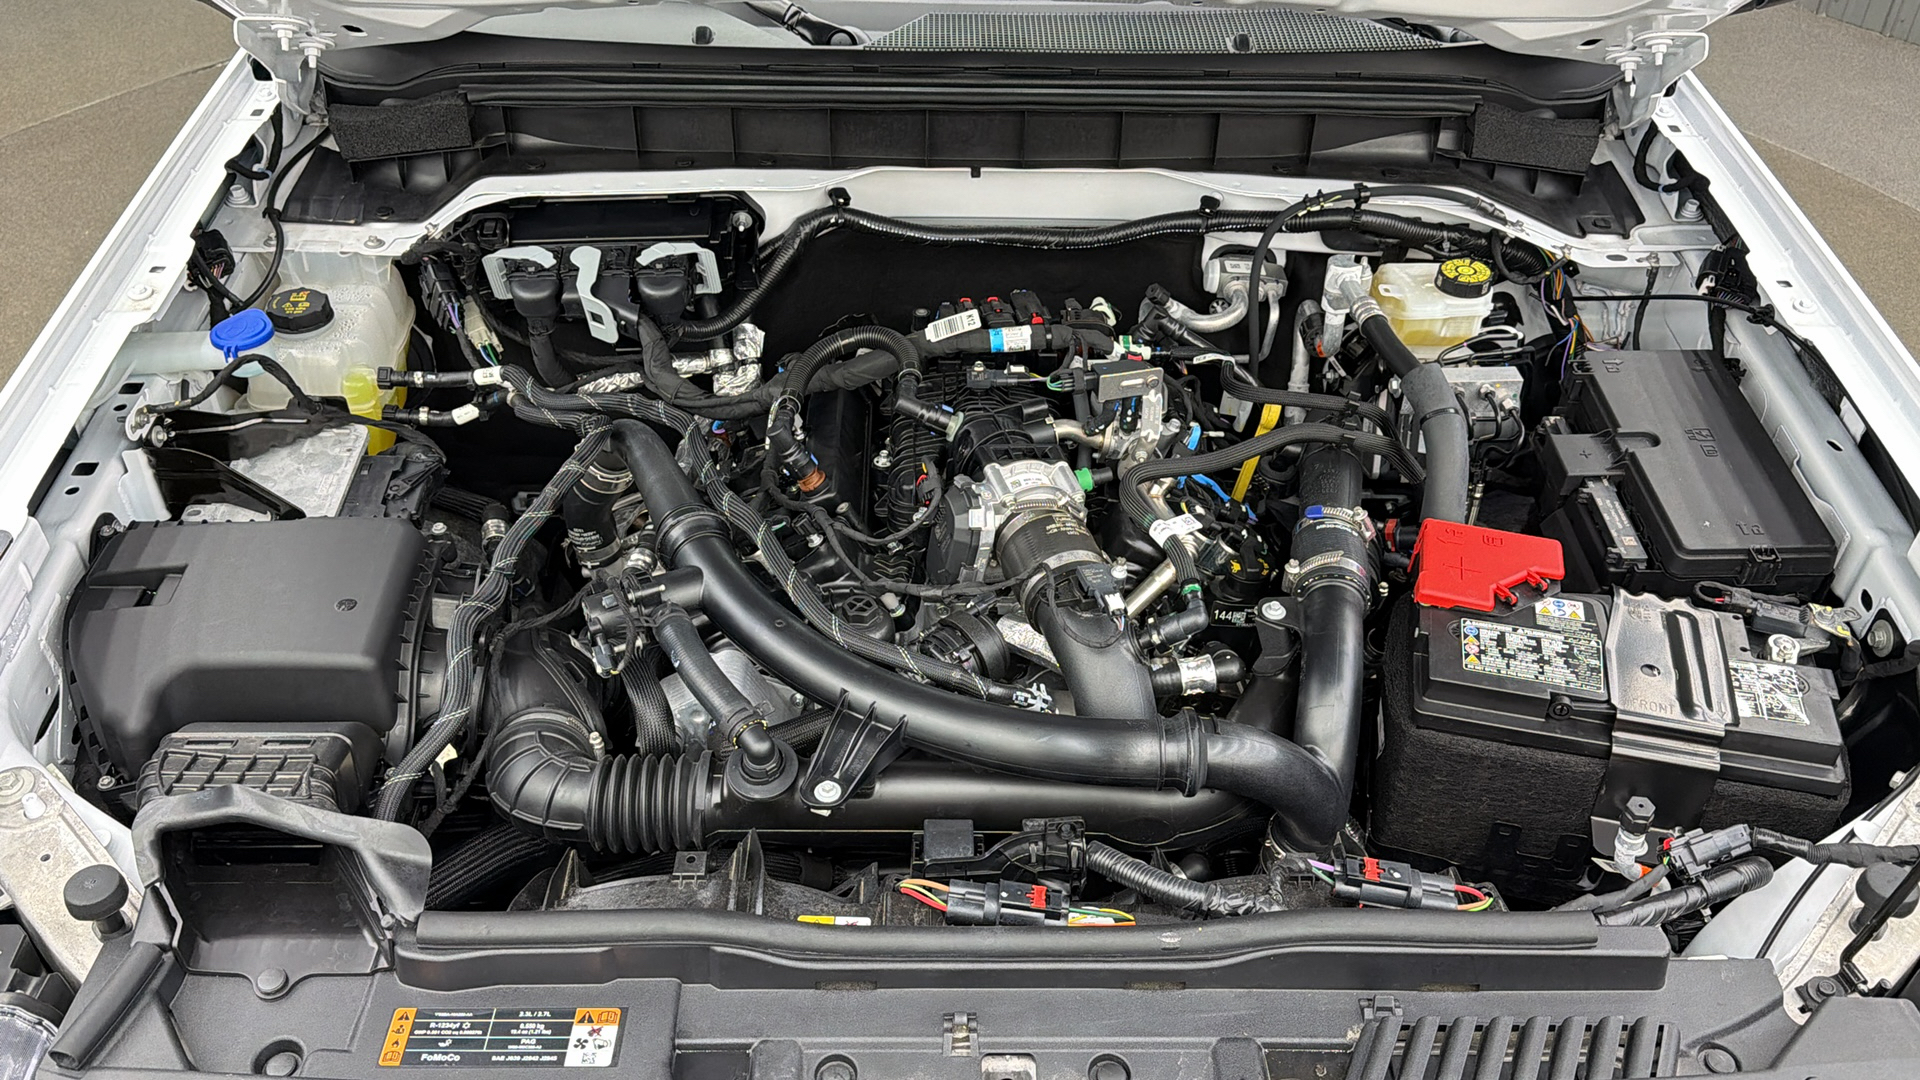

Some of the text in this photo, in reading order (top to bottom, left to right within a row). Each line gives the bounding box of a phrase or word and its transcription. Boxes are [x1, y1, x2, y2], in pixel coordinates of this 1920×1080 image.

[965, 314, 976, 327] K12
[1214, 609, 1232, 620] 144
[1631, 699, 1675, 715] FRONT
[420, 1053, 461, 1061] FoMoCo
